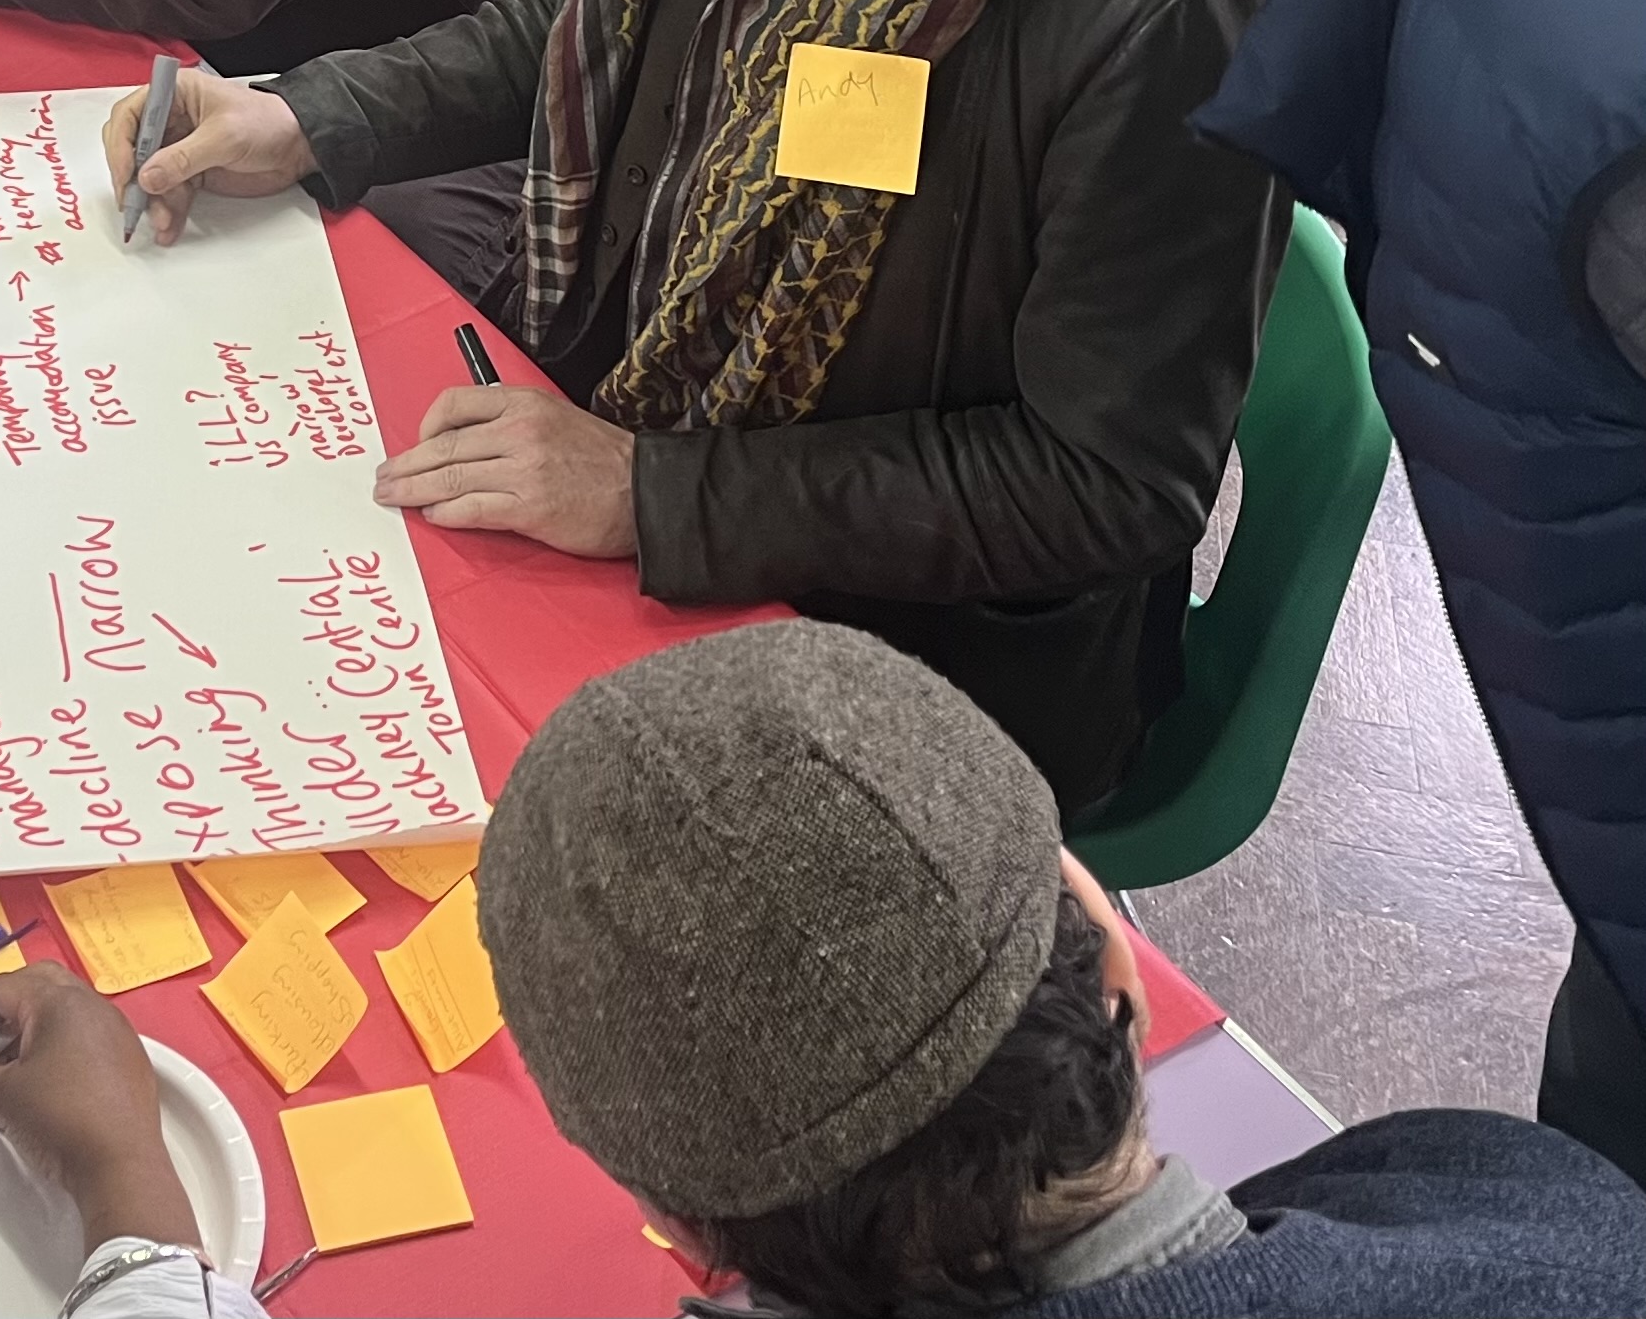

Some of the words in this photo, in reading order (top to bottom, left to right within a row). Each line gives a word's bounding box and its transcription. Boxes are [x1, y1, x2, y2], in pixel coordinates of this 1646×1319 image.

[798, 71, 879, 107] Andy
[84, 363, 137, 427] issue
[345, 550, 421, 651] Centre
[404, 663, 466, 756] Town
[123, 704, 230, 853] xpose
